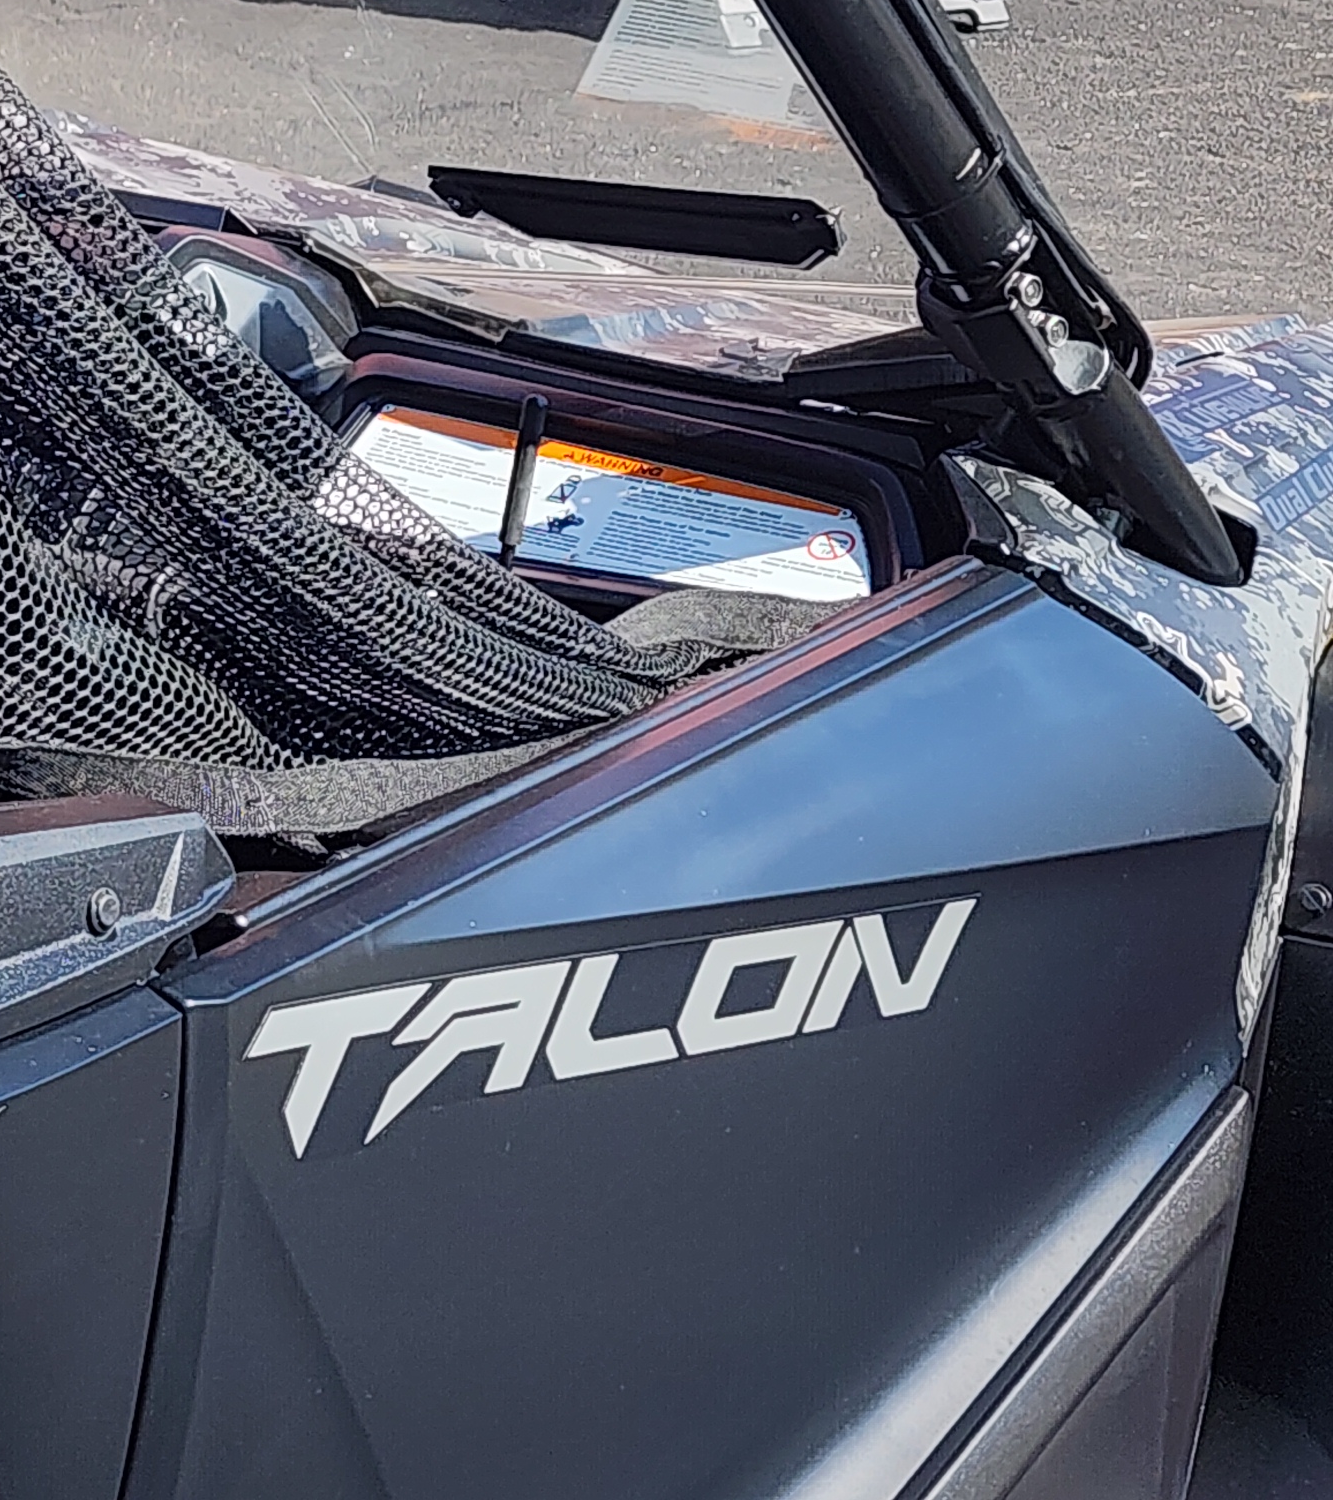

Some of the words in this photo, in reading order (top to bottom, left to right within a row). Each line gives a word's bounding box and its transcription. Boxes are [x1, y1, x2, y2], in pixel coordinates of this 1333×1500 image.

[581, 453, 664, 477] WARNING
[1258, 476, 1313, 532] Dual
[242, 894, 980, 1160] TALON
